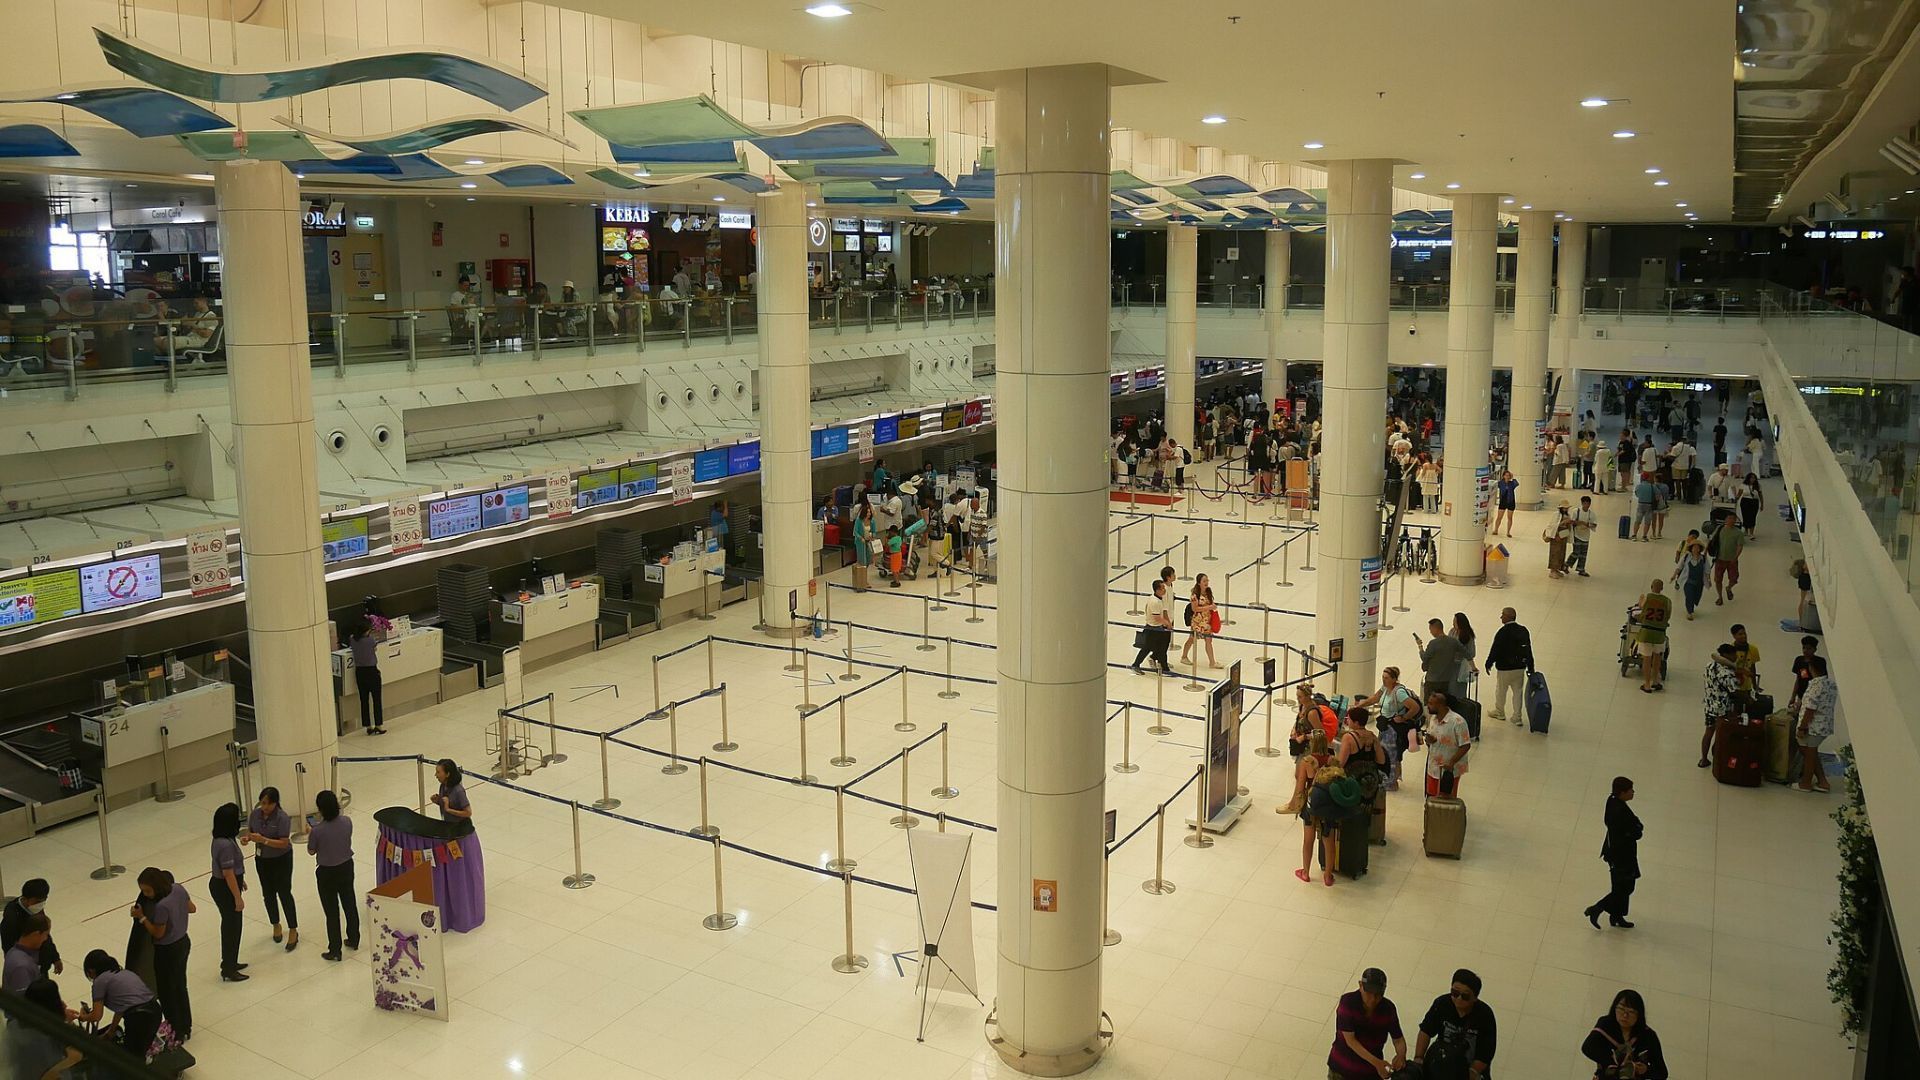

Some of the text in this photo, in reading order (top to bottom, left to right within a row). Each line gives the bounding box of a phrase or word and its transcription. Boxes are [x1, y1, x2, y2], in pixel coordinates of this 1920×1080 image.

[606, 208, 650, 223] KEBAB
[720, 214, 745, 224] Cash Card
[331, 250, 341, 266] 3
[431, 502, 450, 514] NO!
[117, 540, 133, 550] D25
[191, 542, 209, 554] ห้าม
[33, 554, 51, 565] D24
[109, 719, 130, 737] 24
